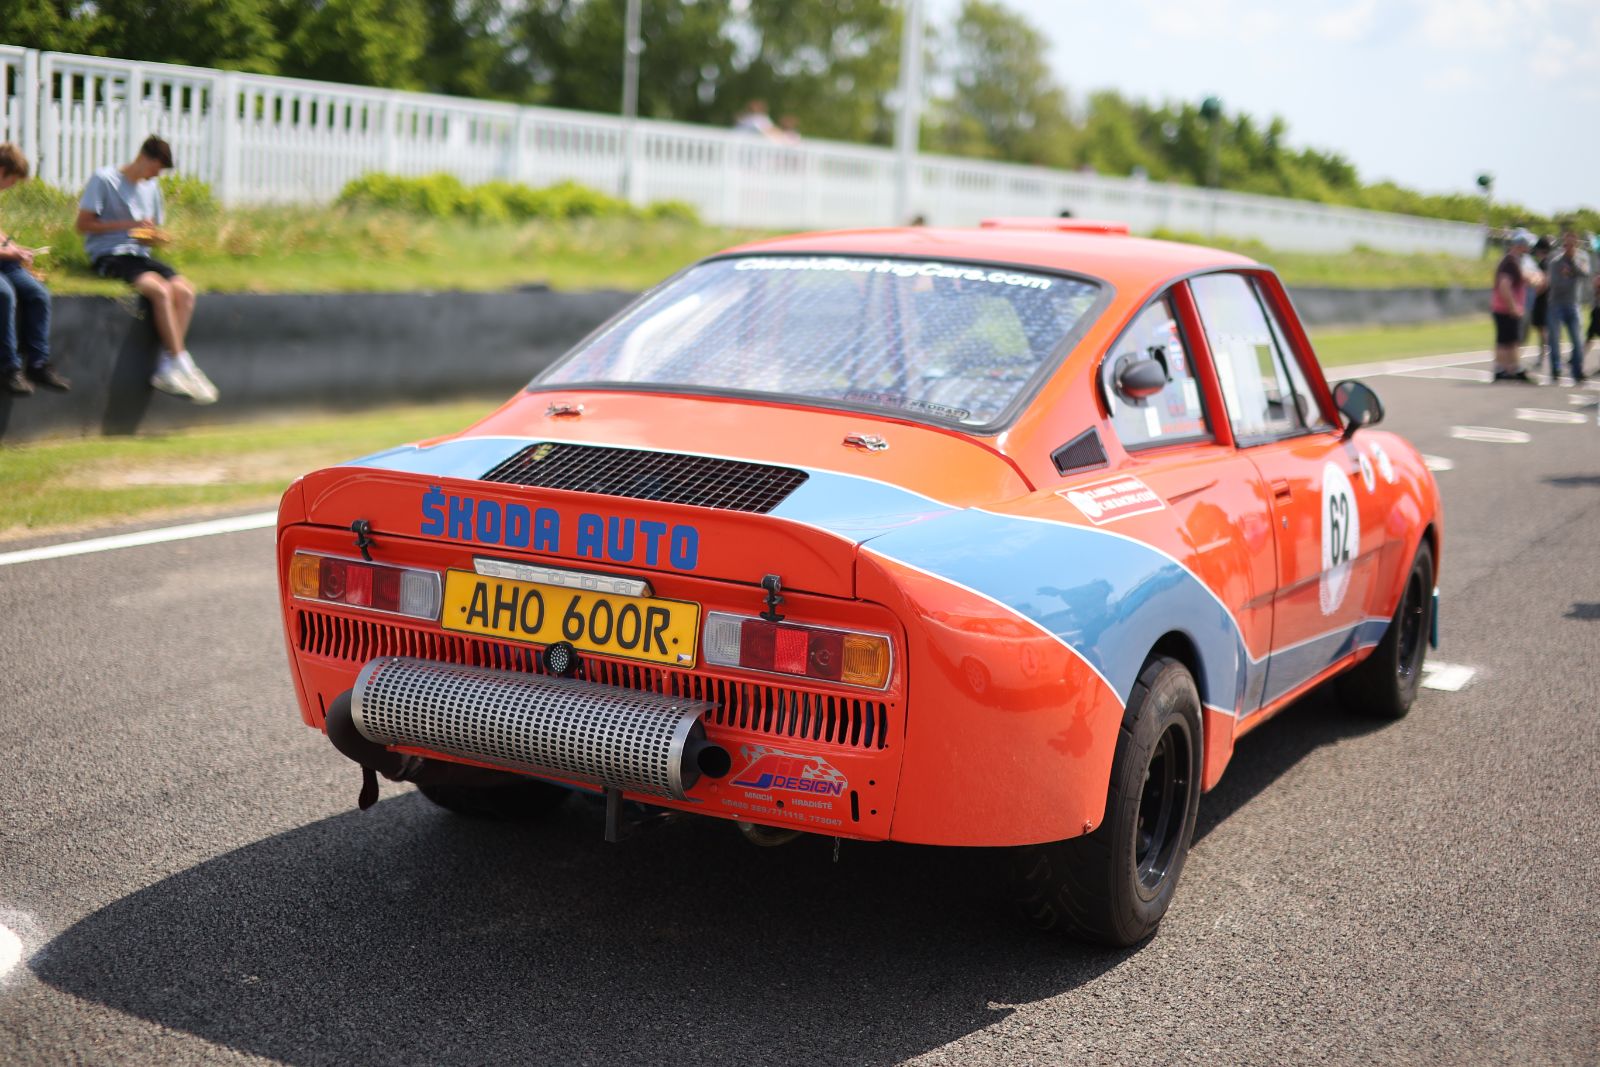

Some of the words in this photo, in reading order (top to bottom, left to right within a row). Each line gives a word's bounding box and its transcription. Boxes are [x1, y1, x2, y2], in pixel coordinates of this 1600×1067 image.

[420, 485, 560, 553] ŠKODA
[577, 513, 699, 571] AUTO
[1330, 492, 1349, 567] 62
[466, 582, 545, 634] AHO
[562, 595, 671, 655] 600R
[773, 776, 844, 796] DESIGN
